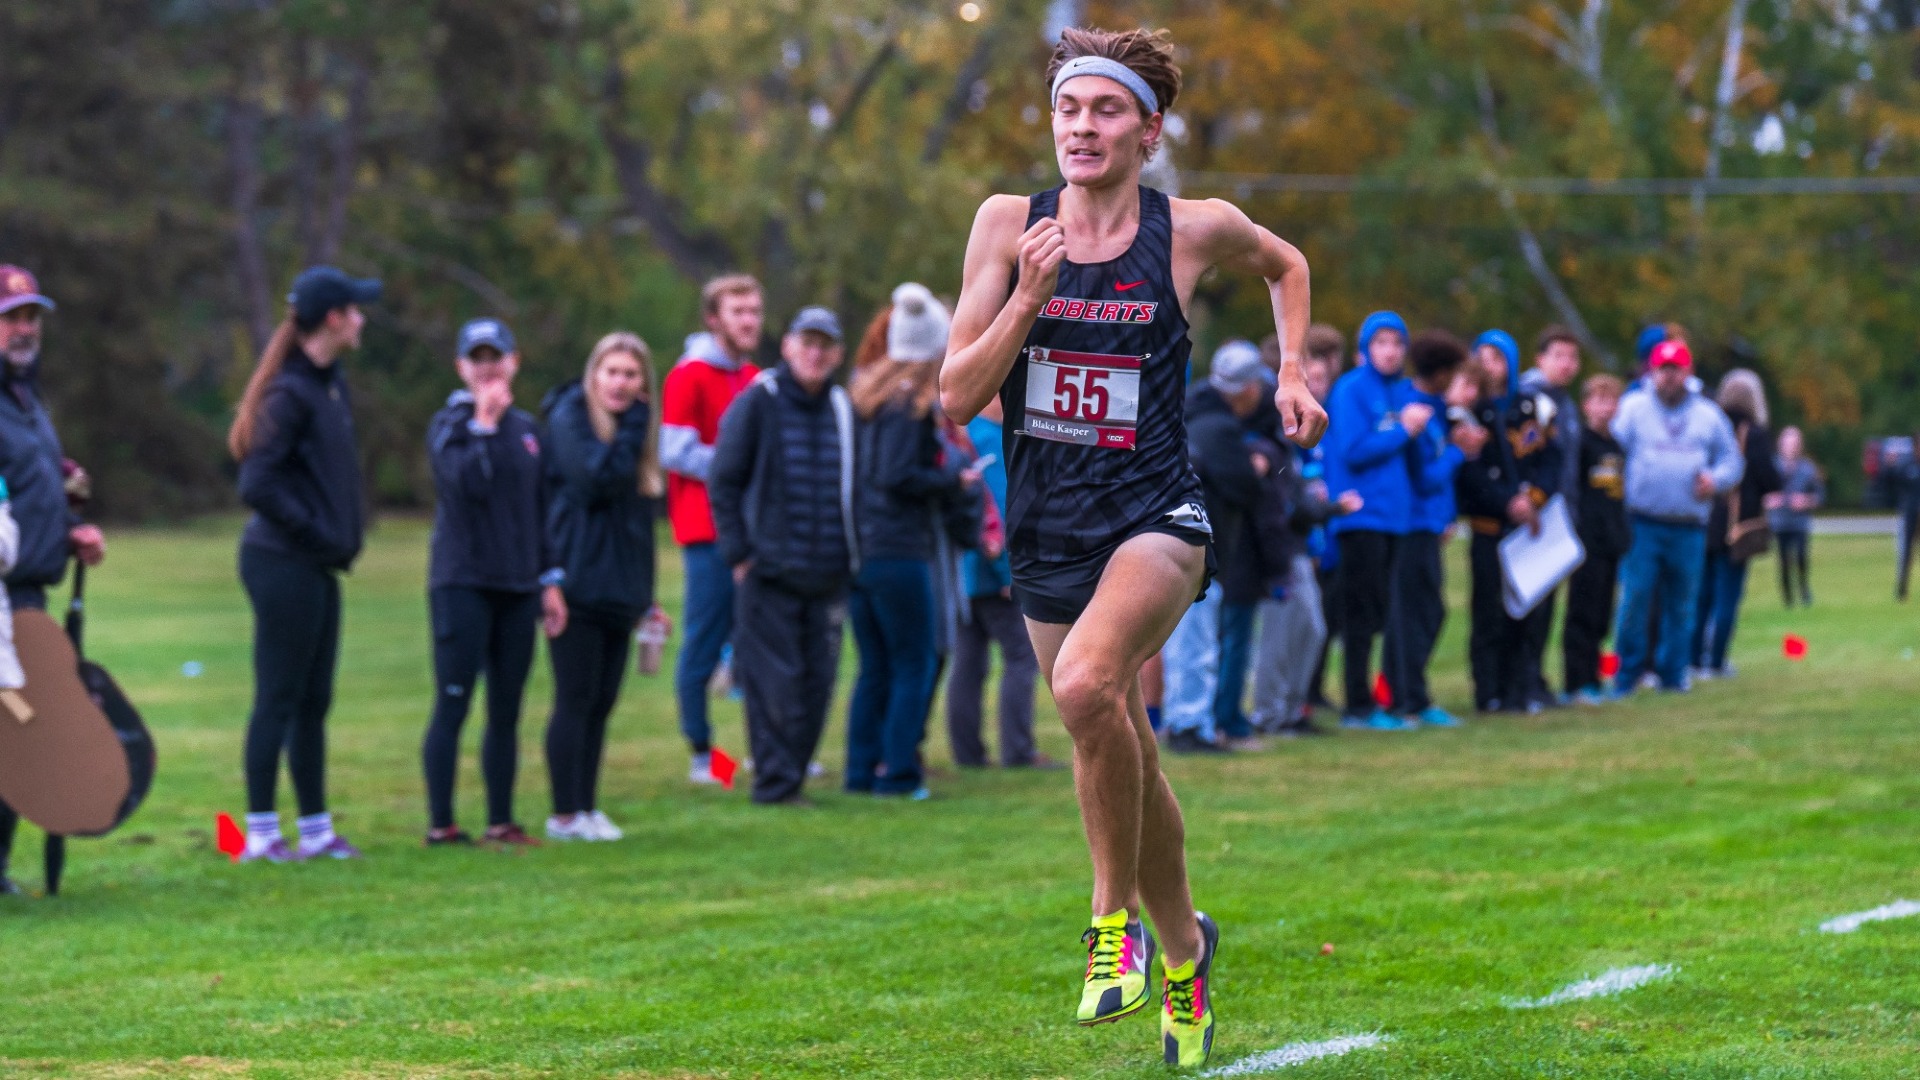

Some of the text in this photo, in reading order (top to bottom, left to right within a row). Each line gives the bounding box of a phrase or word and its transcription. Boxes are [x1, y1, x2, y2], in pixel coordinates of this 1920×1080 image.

[1053, 366, 1110, 422] 55
[1032, 419, 1056, 431] Blake
[1057, 423, 1089, 437] Kasper
